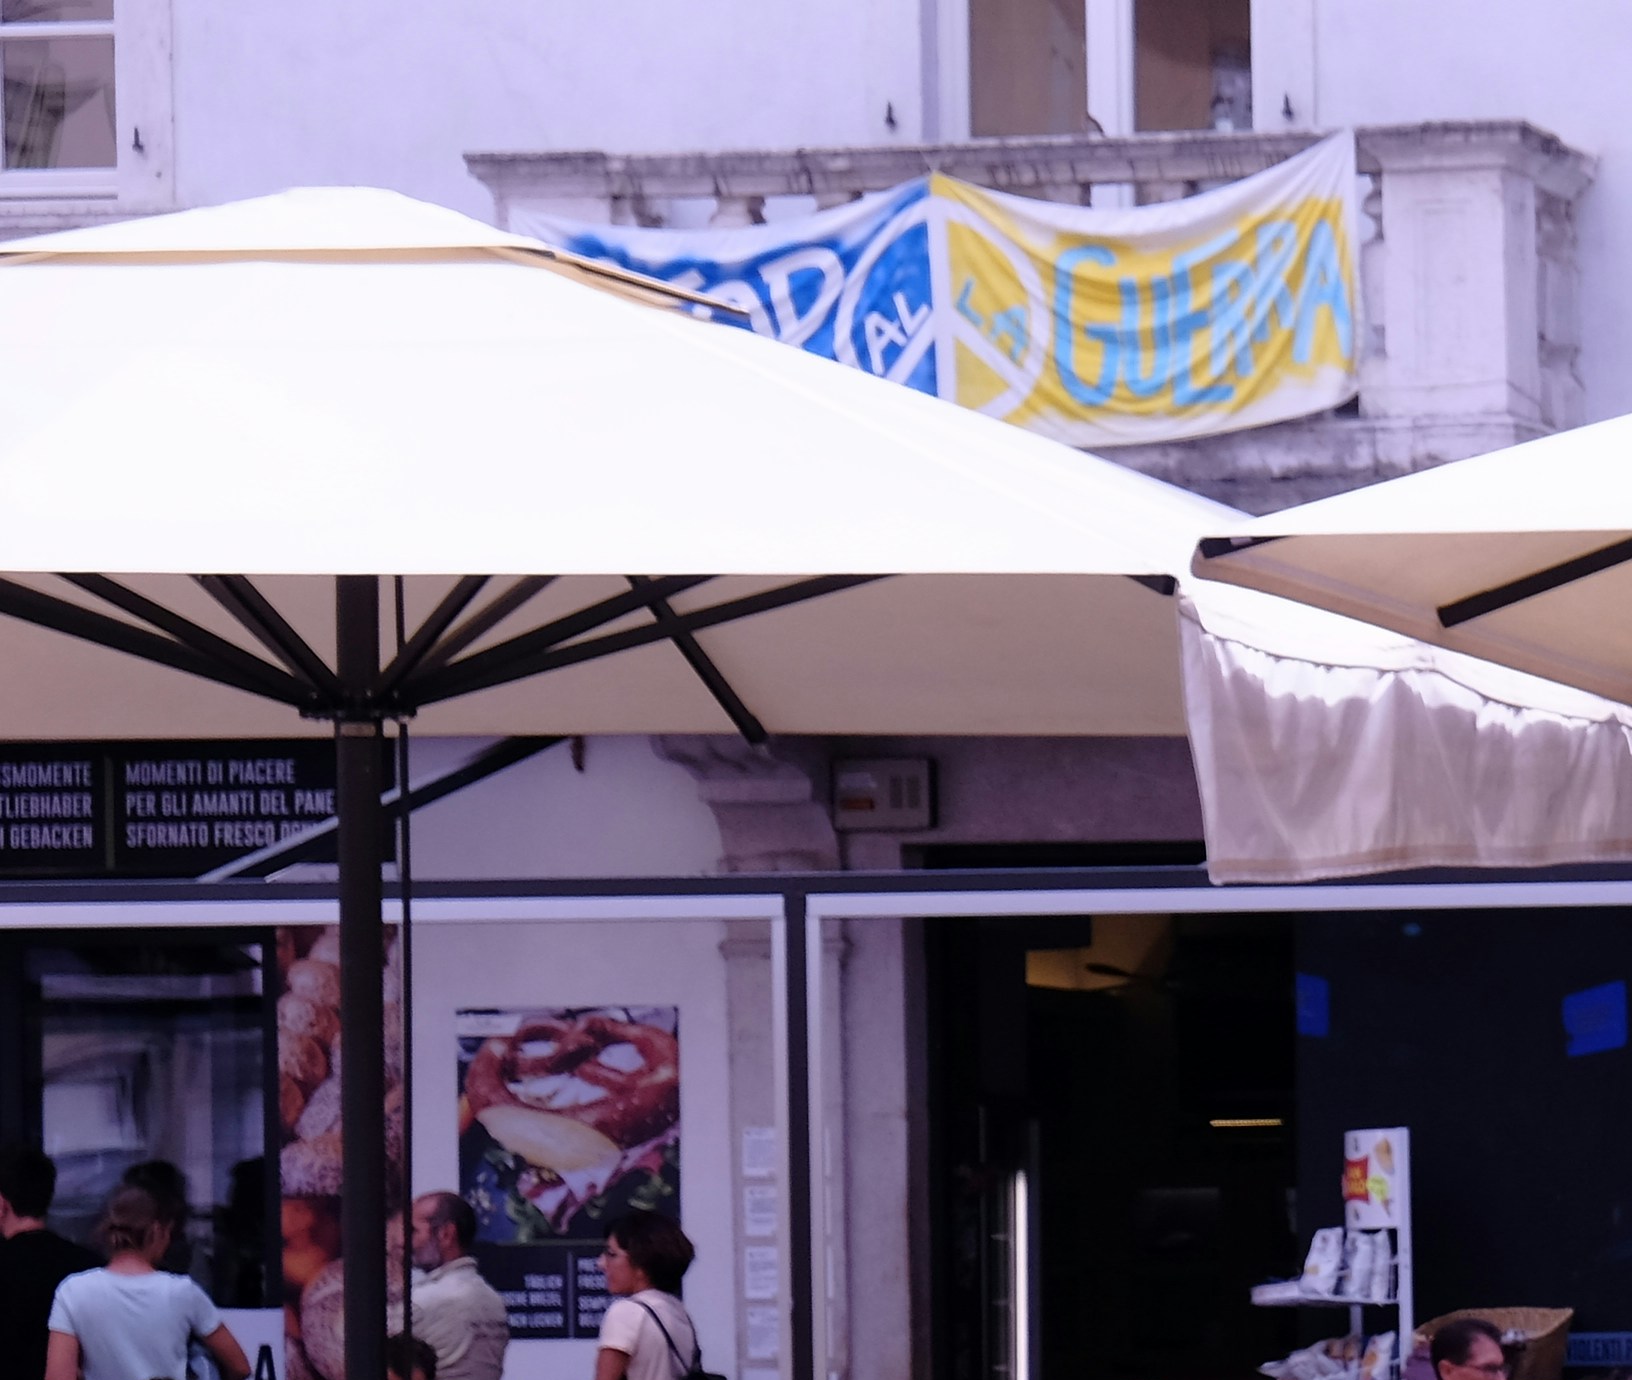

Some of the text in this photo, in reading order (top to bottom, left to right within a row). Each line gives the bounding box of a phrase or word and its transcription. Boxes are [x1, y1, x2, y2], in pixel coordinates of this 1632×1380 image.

[864, 291, 935, 376] AL
[955, 276, 1030, 363] LA
[1054, 217, 1353, 407] GUERRA
[125, 759, 295, 787] MOMENTI DI PIACERE
[126, 788, 335, 817] PER GLI AMANTI DEL PANE
[10, 824, 93, 849] GEBACKEN
[126, 823, 208, 848] SFORNATO
[214, 821, 275, 847] FRESCO
